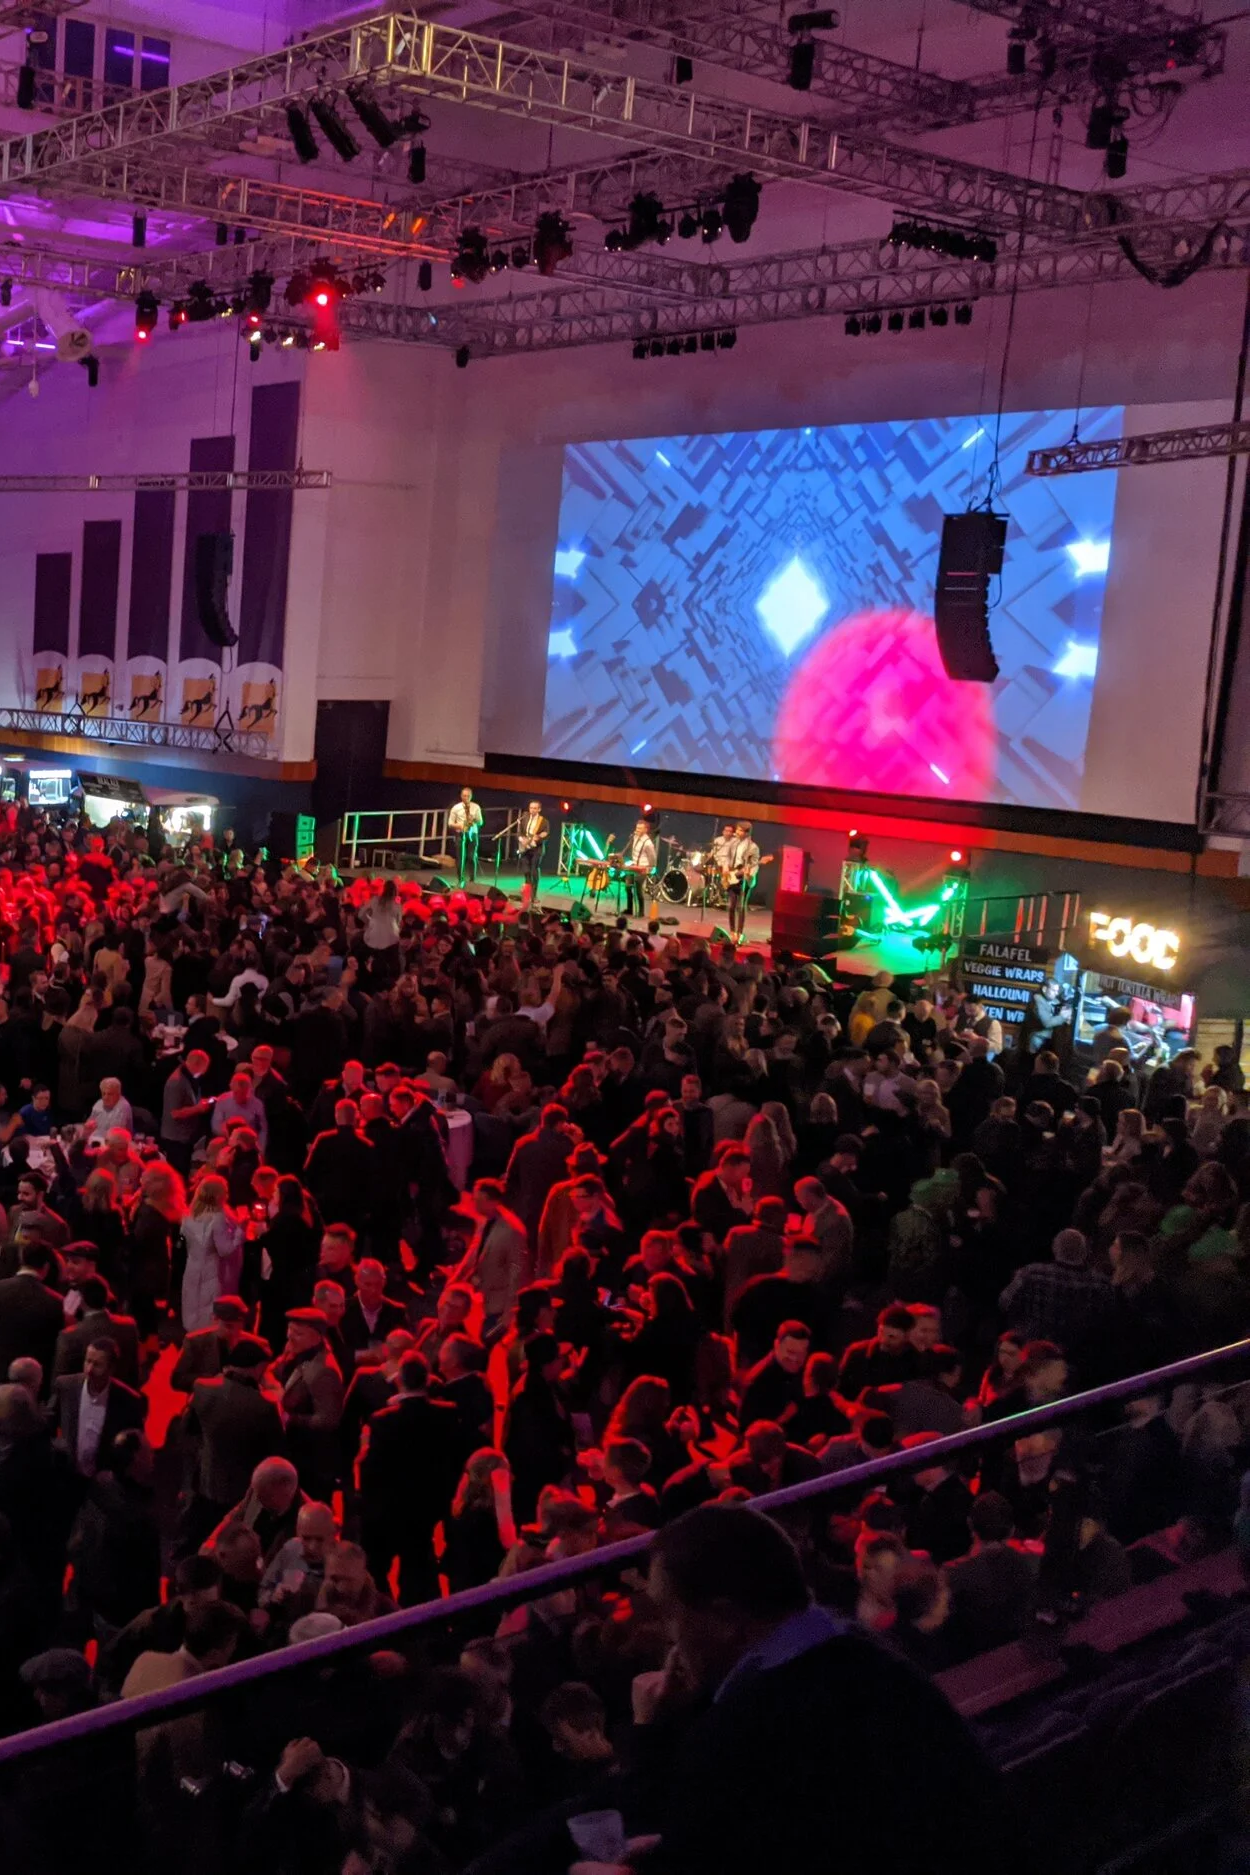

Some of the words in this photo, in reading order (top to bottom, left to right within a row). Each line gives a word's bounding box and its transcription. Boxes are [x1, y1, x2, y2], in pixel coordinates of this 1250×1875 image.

[980, 944, 1031, 961] FALAFEL
[965, 961, 1001, 976] VEGGIE
[1005, 967, 1044, 982] WRAPS
[973, 983, 1029, 1003] HALLOUMI
